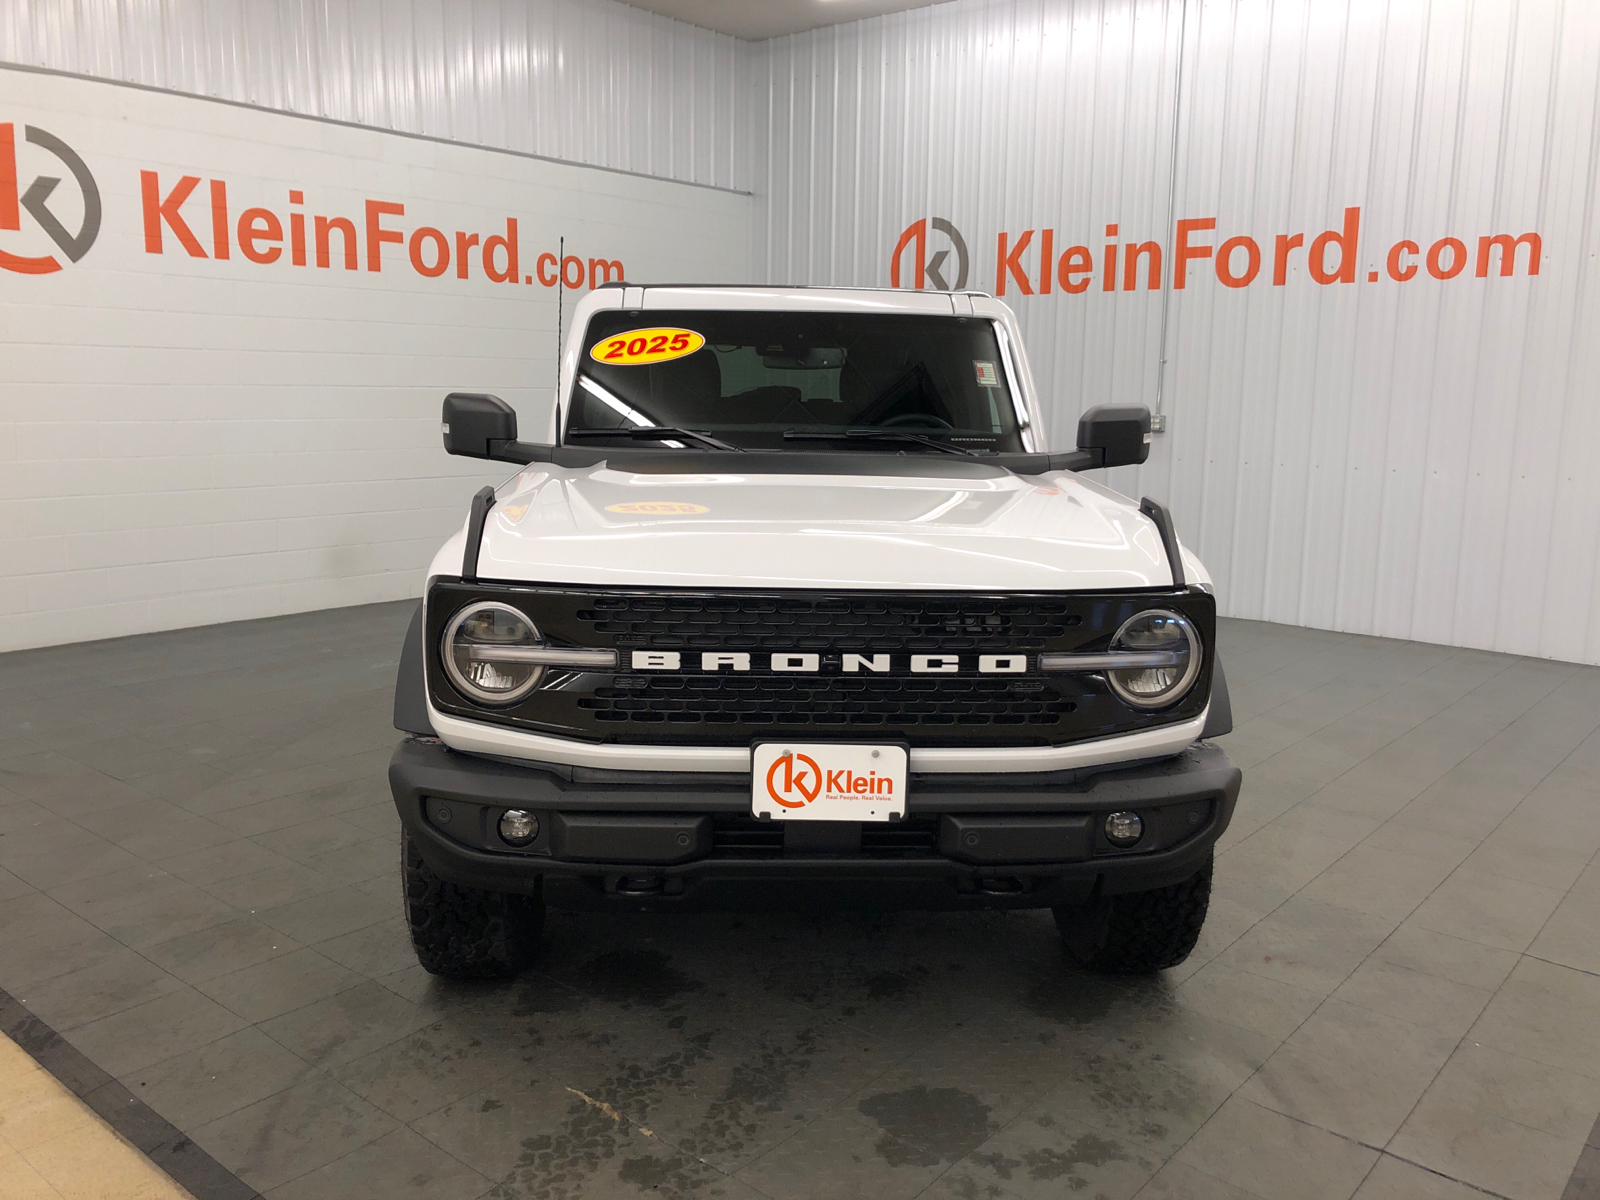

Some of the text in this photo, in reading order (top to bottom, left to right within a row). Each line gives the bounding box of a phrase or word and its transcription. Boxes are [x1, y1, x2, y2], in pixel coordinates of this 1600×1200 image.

[140, 169, 624, 290] KleinFord.com
[996, 207, 1542, 297] KleinFord.com
[604, 333, 691, 359] 2025
[631, 651, 1027, 673] BRONCO
[826, 770, 893, 794] Klein
